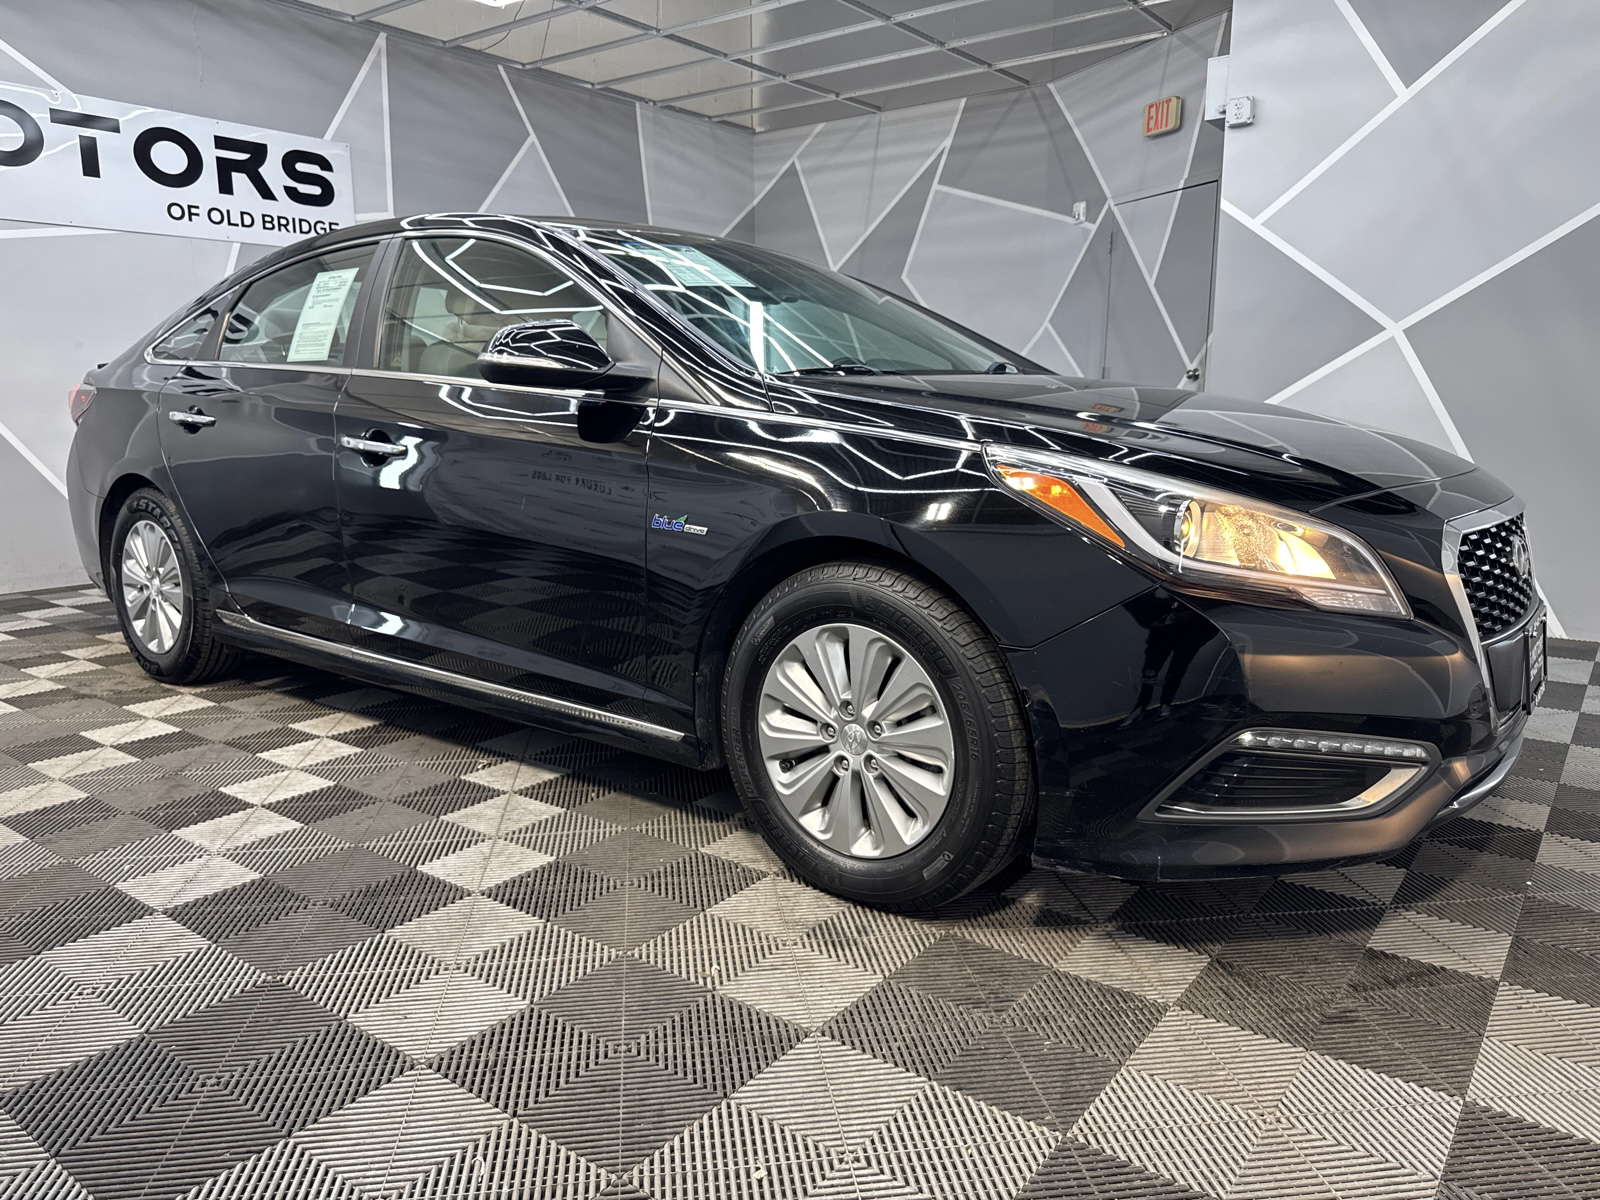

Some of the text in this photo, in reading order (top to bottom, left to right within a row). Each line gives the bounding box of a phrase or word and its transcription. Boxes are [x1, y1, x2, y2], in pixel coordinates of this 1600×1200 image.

[1146, 98, 1172, 133] EXIT
[167, 202, 200, 222] OF
[207, 207, 255, 229] OLD
[651, 513, 706, 534] blue drive
[877, 603, 953, 677] MICHELIN
[952, 683, 981, 763] 205/65R16
[732, 726, 756, 795] DEFENDER
